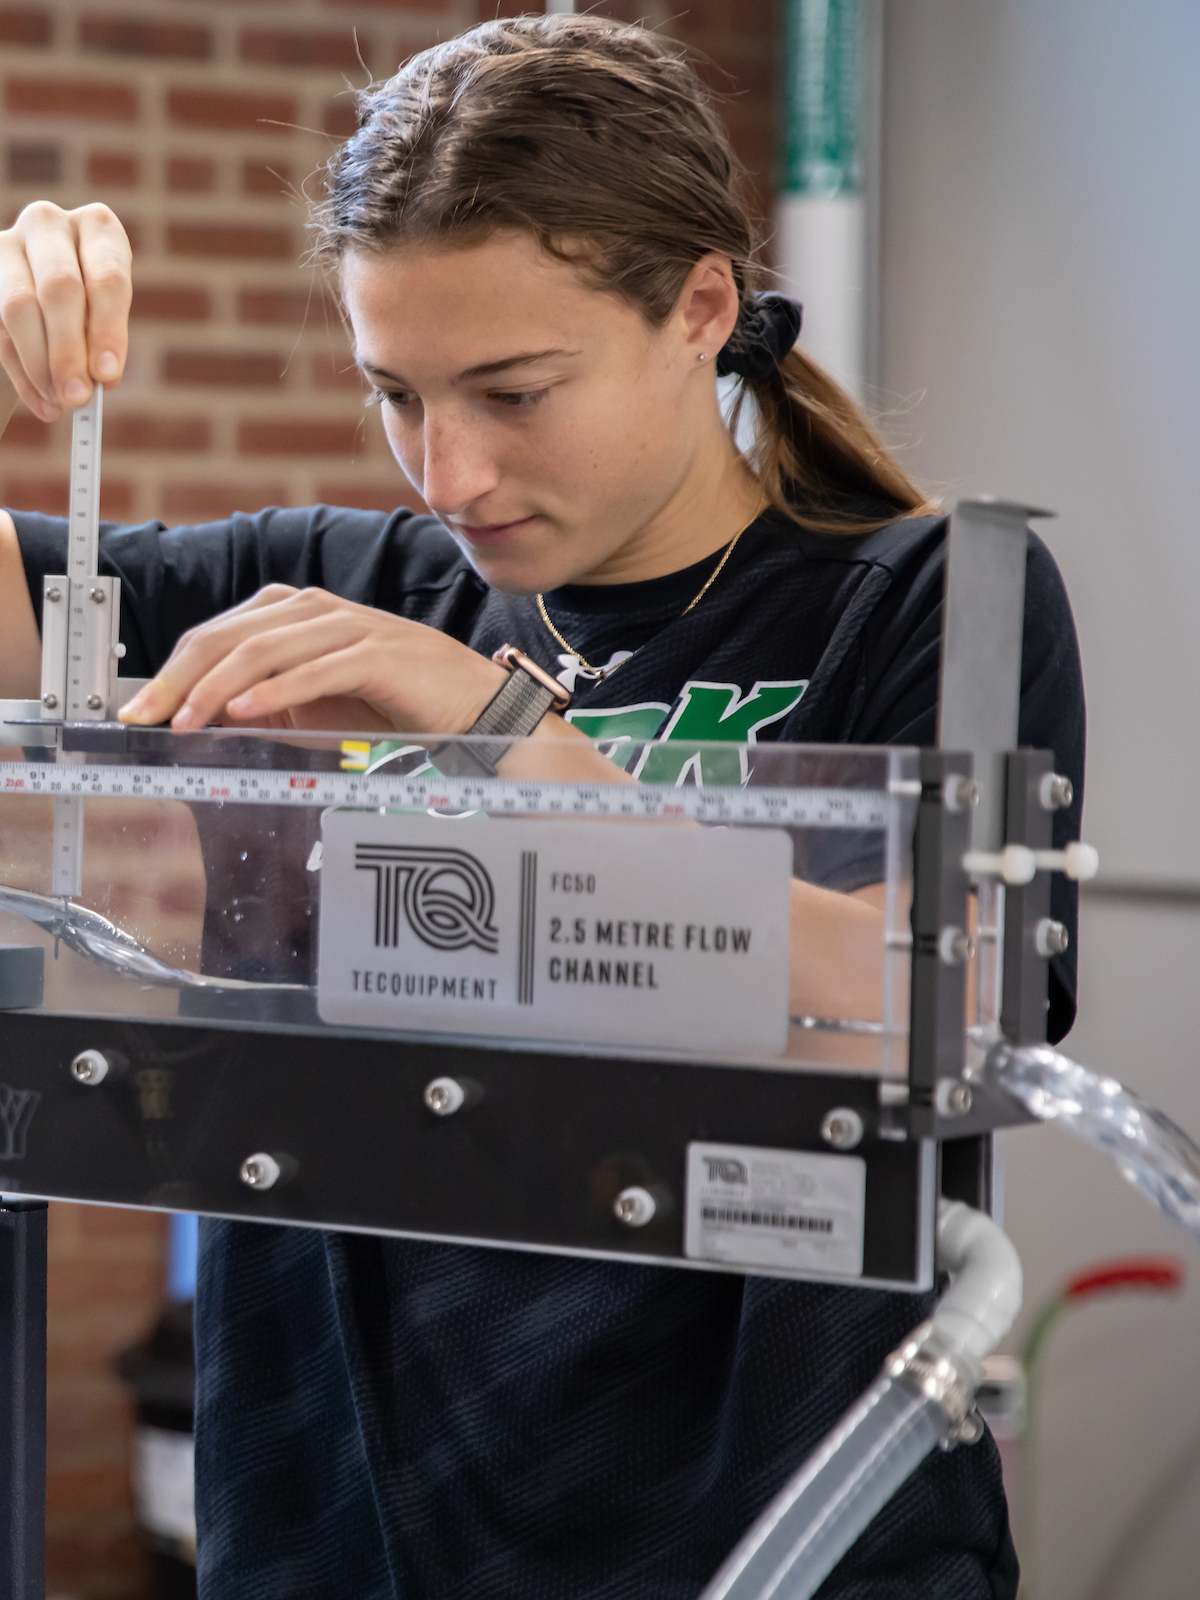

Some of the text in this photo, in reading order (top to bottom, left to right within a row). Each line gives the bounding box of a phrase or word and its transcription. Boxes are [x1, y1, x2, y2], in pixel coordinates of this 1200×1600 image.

[82, 773, 99, 781] 92
[134, 775, 151, 784] 93
[355, 843, 499, 953] TQ
[552, 873, 595, 894] FC50
[550, 918, 752, 953] 2.5 METRE FLOW
[353, 971, 497, 1000] TECQUIPMENT
[549, 957, 659, 989] CHANNEL
[702, 1155, 747, 1185] TQ
